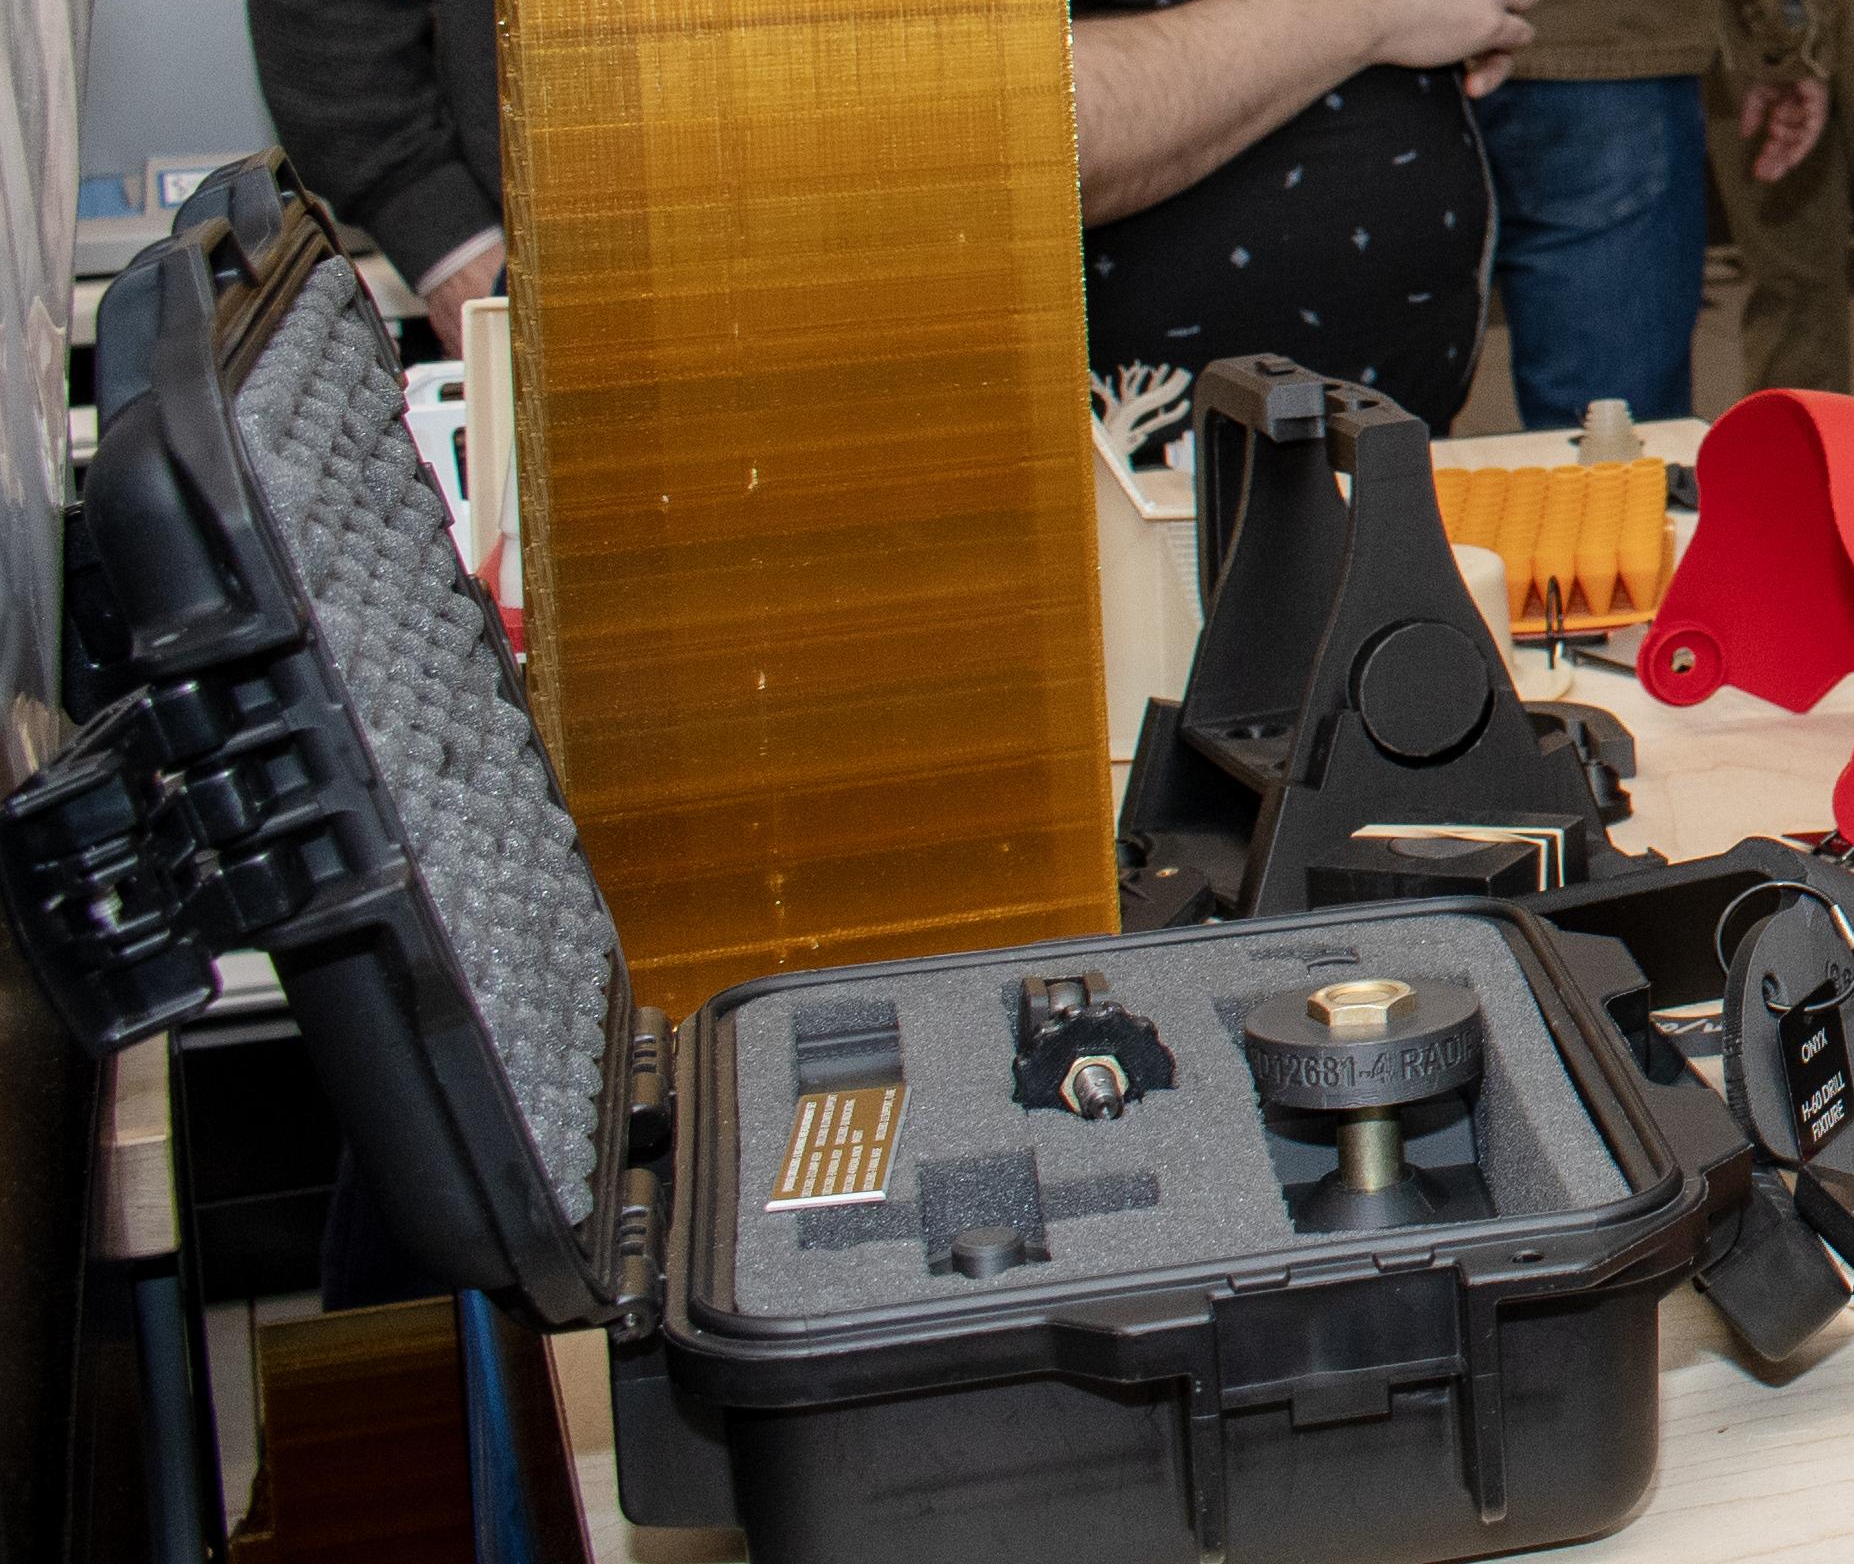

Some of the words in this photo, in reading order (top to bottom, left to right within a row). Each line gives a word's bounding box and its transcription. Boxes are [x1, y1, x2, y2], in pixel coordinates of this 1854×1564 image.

[1801, 1027, 1829, 1064] ONYX
[1801, 1089, 1824, 1123] H-60
[1821, 1070, 1846, 1105] DRILL
[1812, 1098, 1845, 1142] FIXTURE
